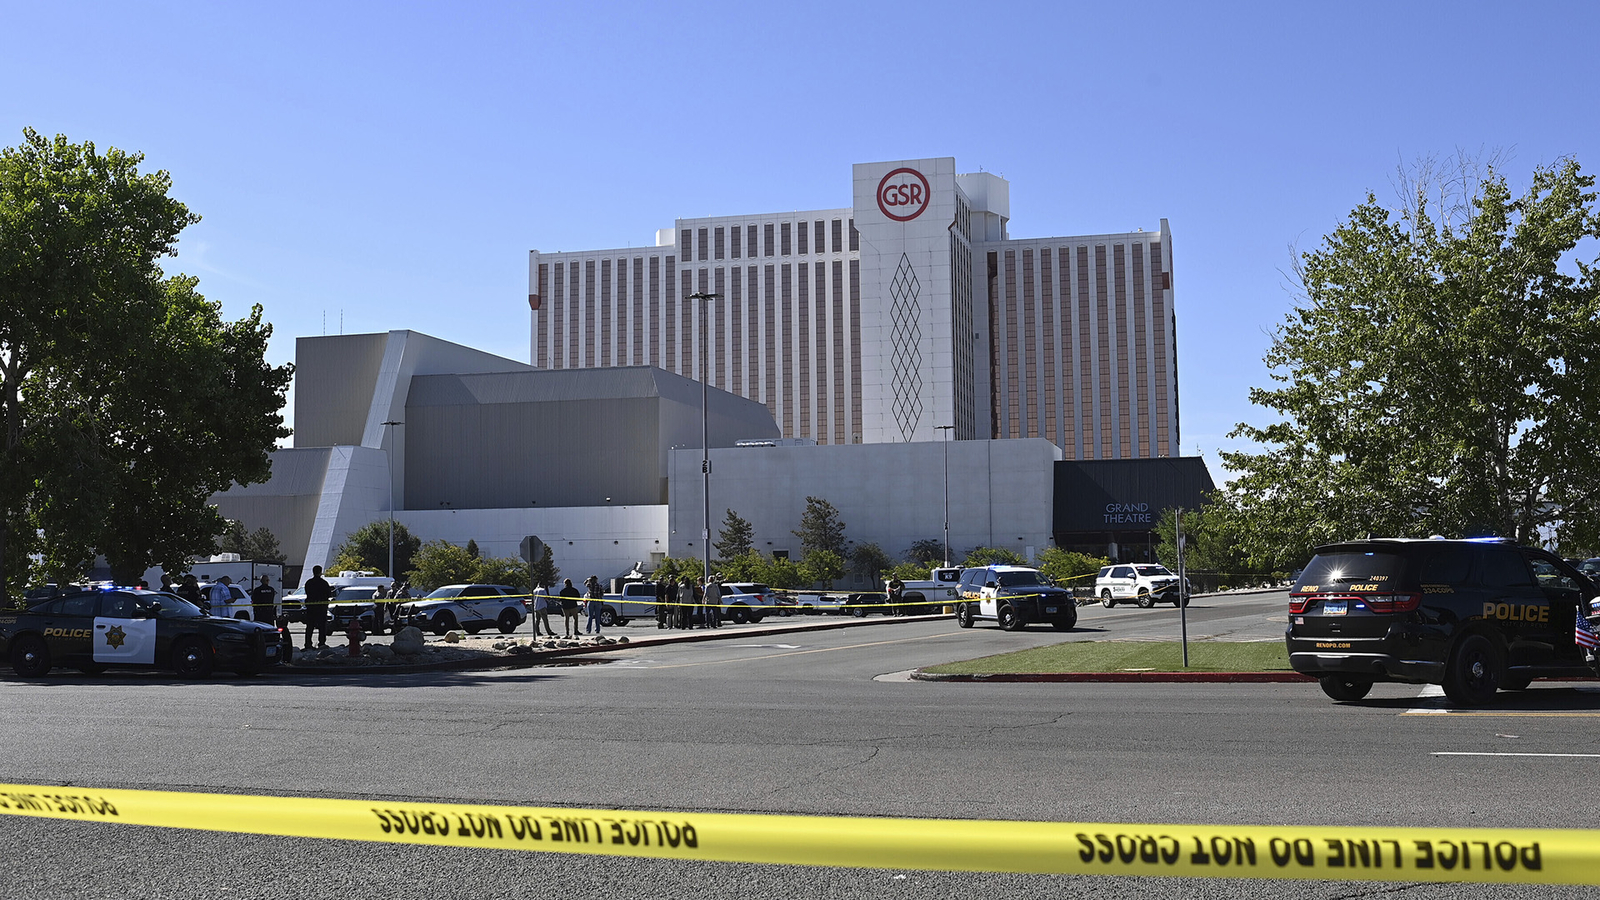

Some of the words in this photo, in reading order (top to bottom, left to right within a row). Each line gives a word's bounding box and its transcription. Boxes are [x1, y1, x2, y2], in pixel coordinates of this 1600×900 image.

[883, 183, 922, 206] GSR
[1103, 513, 1151, 524] THEATRE
[1105, 502, 1149, 513] GRAND
[1349, 584, 1379, 592] POLICE
[1482, 602, 1551, 622] POLICE
[43, 627, 93, 638] POLICE
[371, 809, 449, 837] CROSS
[450, 812, 503, 839] NOT
[505, 815, 542, 841] DO
[541, 816, 603, 844] LINE
[602, 818, 698, 849] POLICE
[1074, 833, 1180, 866] CROSS
[1191, 836, 1257, 867] NOT
[1269, 837, 1314, 868] DO
[1324, 839, 1402, 869] LINE
[1413, 840, 1542, 872] POLICE
